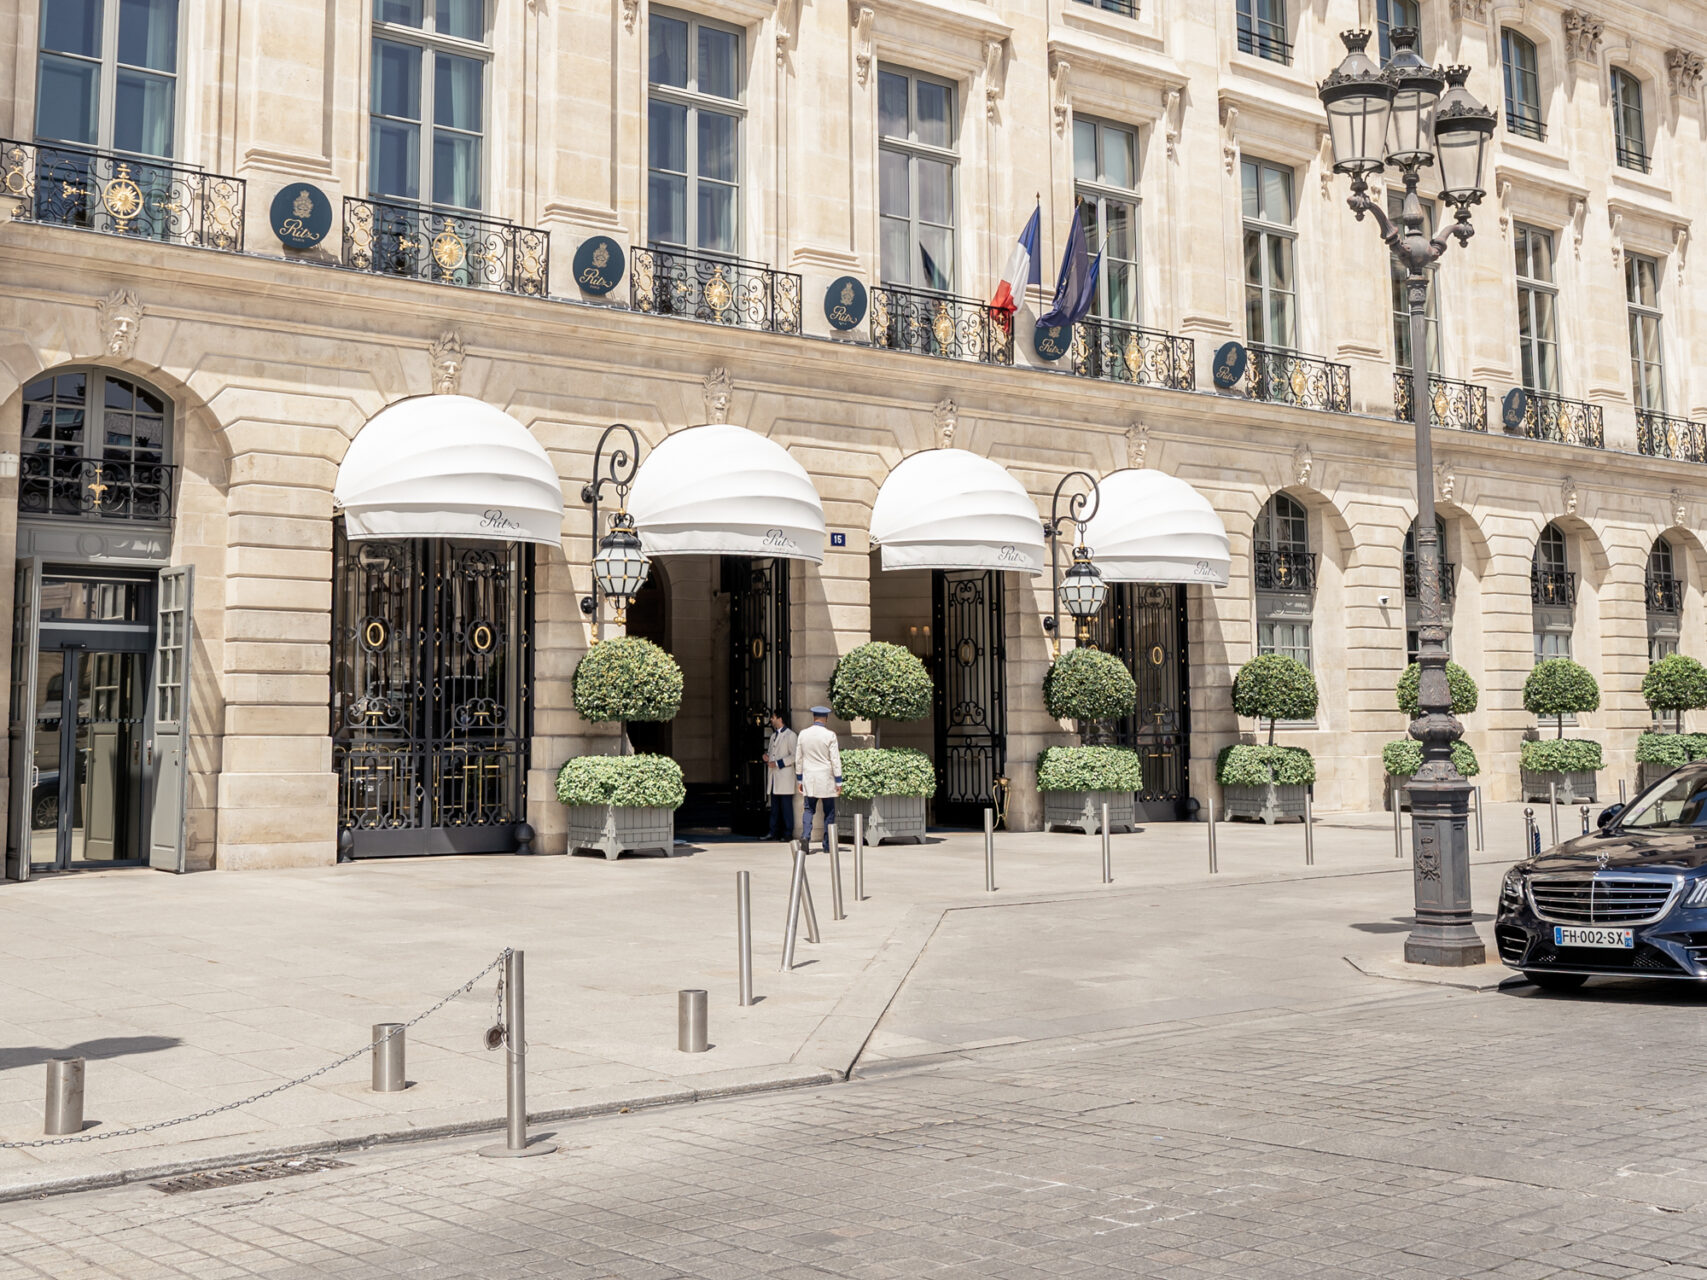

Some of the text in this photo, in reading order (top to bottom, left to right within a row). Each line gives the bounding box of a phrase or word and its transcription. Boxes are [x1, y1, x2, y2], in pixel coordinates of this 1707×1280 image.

[279, 218, 320, 240] Ritz
[579, 267, 613, 288] Ritz
[479, 509, 520, 530] Ritz
[762, 528, 797, 548] Ritz
[833, 534, 842, 544] 15
[1562, 929, 1624, 945] FH-002-SX
